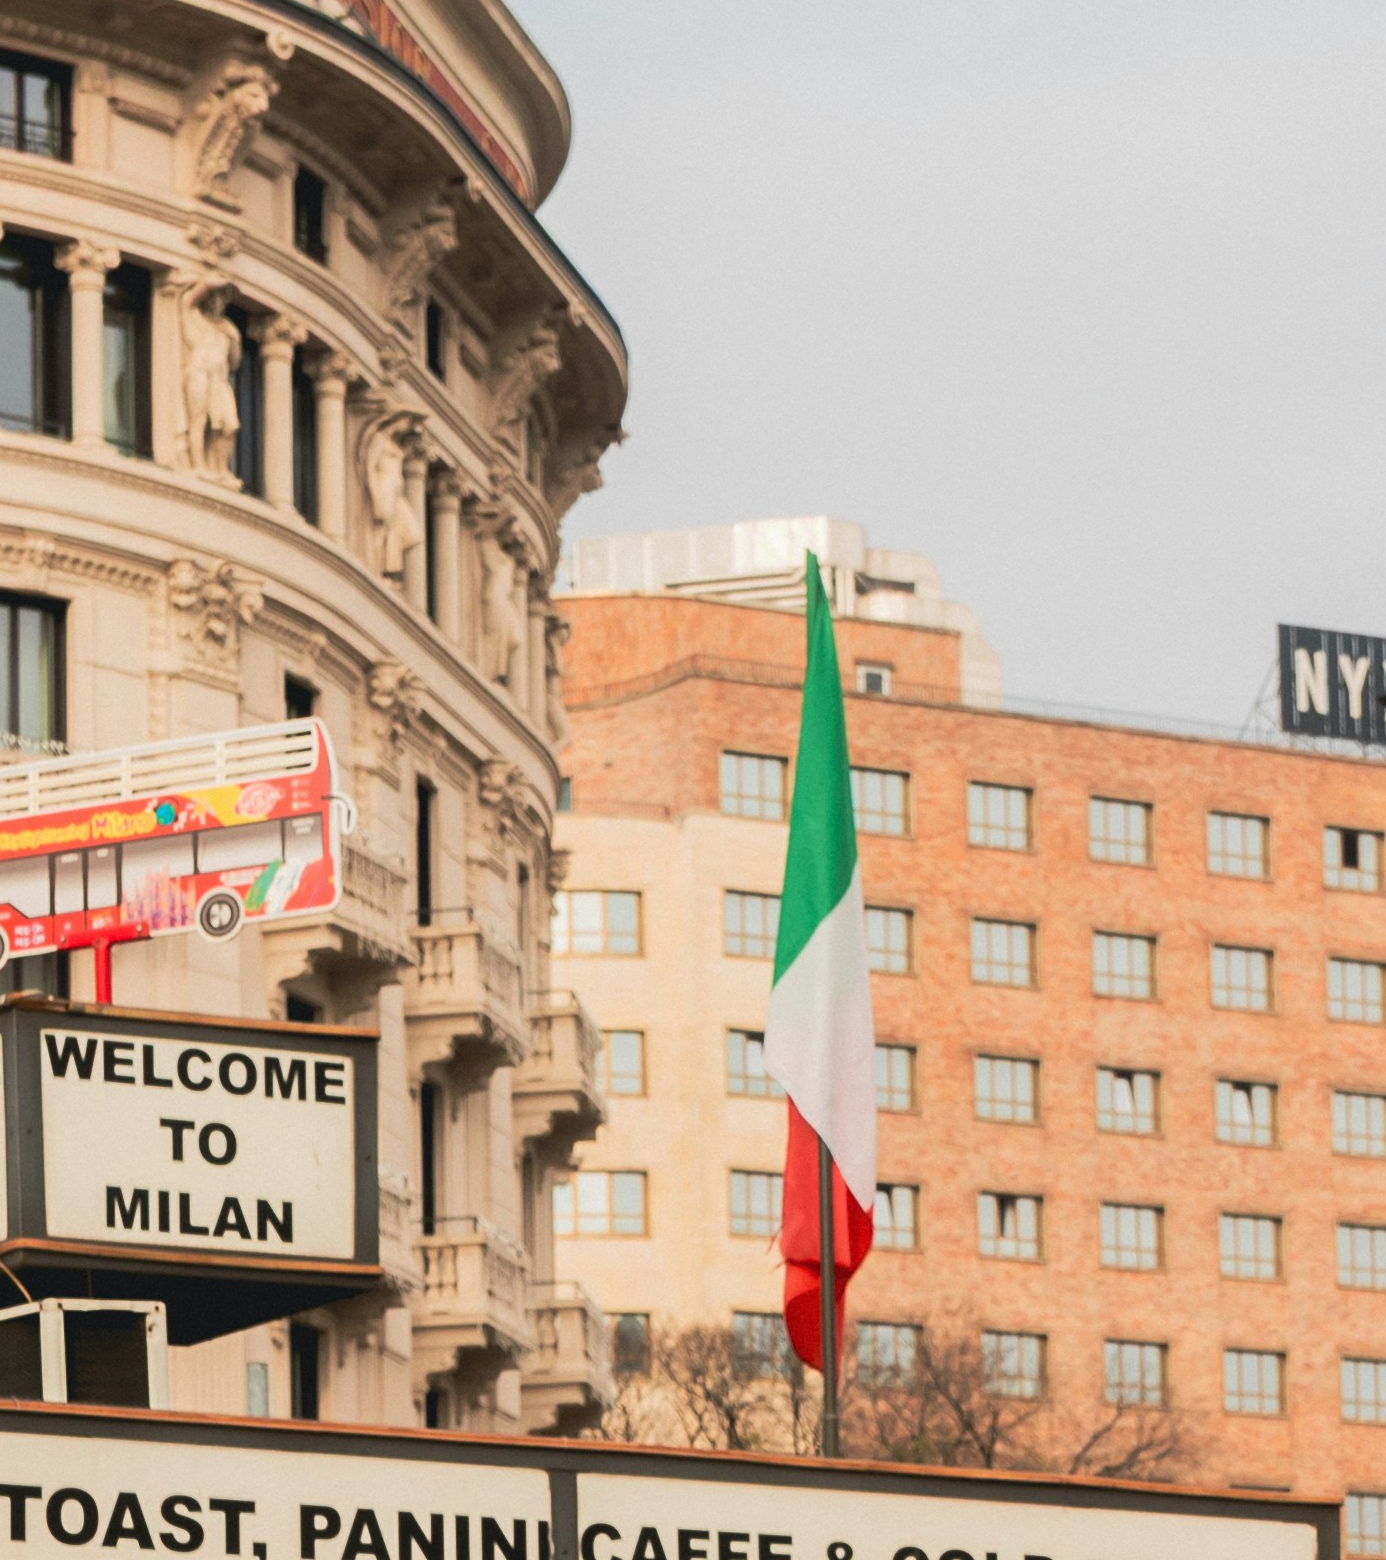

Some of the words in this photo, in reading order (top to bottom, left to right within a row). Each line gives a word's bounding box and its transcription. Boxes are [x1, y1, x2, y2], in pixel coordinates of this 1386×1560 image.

[44, 1034, 347, 1105] WELCOME
[159, 1117, 238, 1166] TO
[105, 1185, 294, 1243] MILAN
